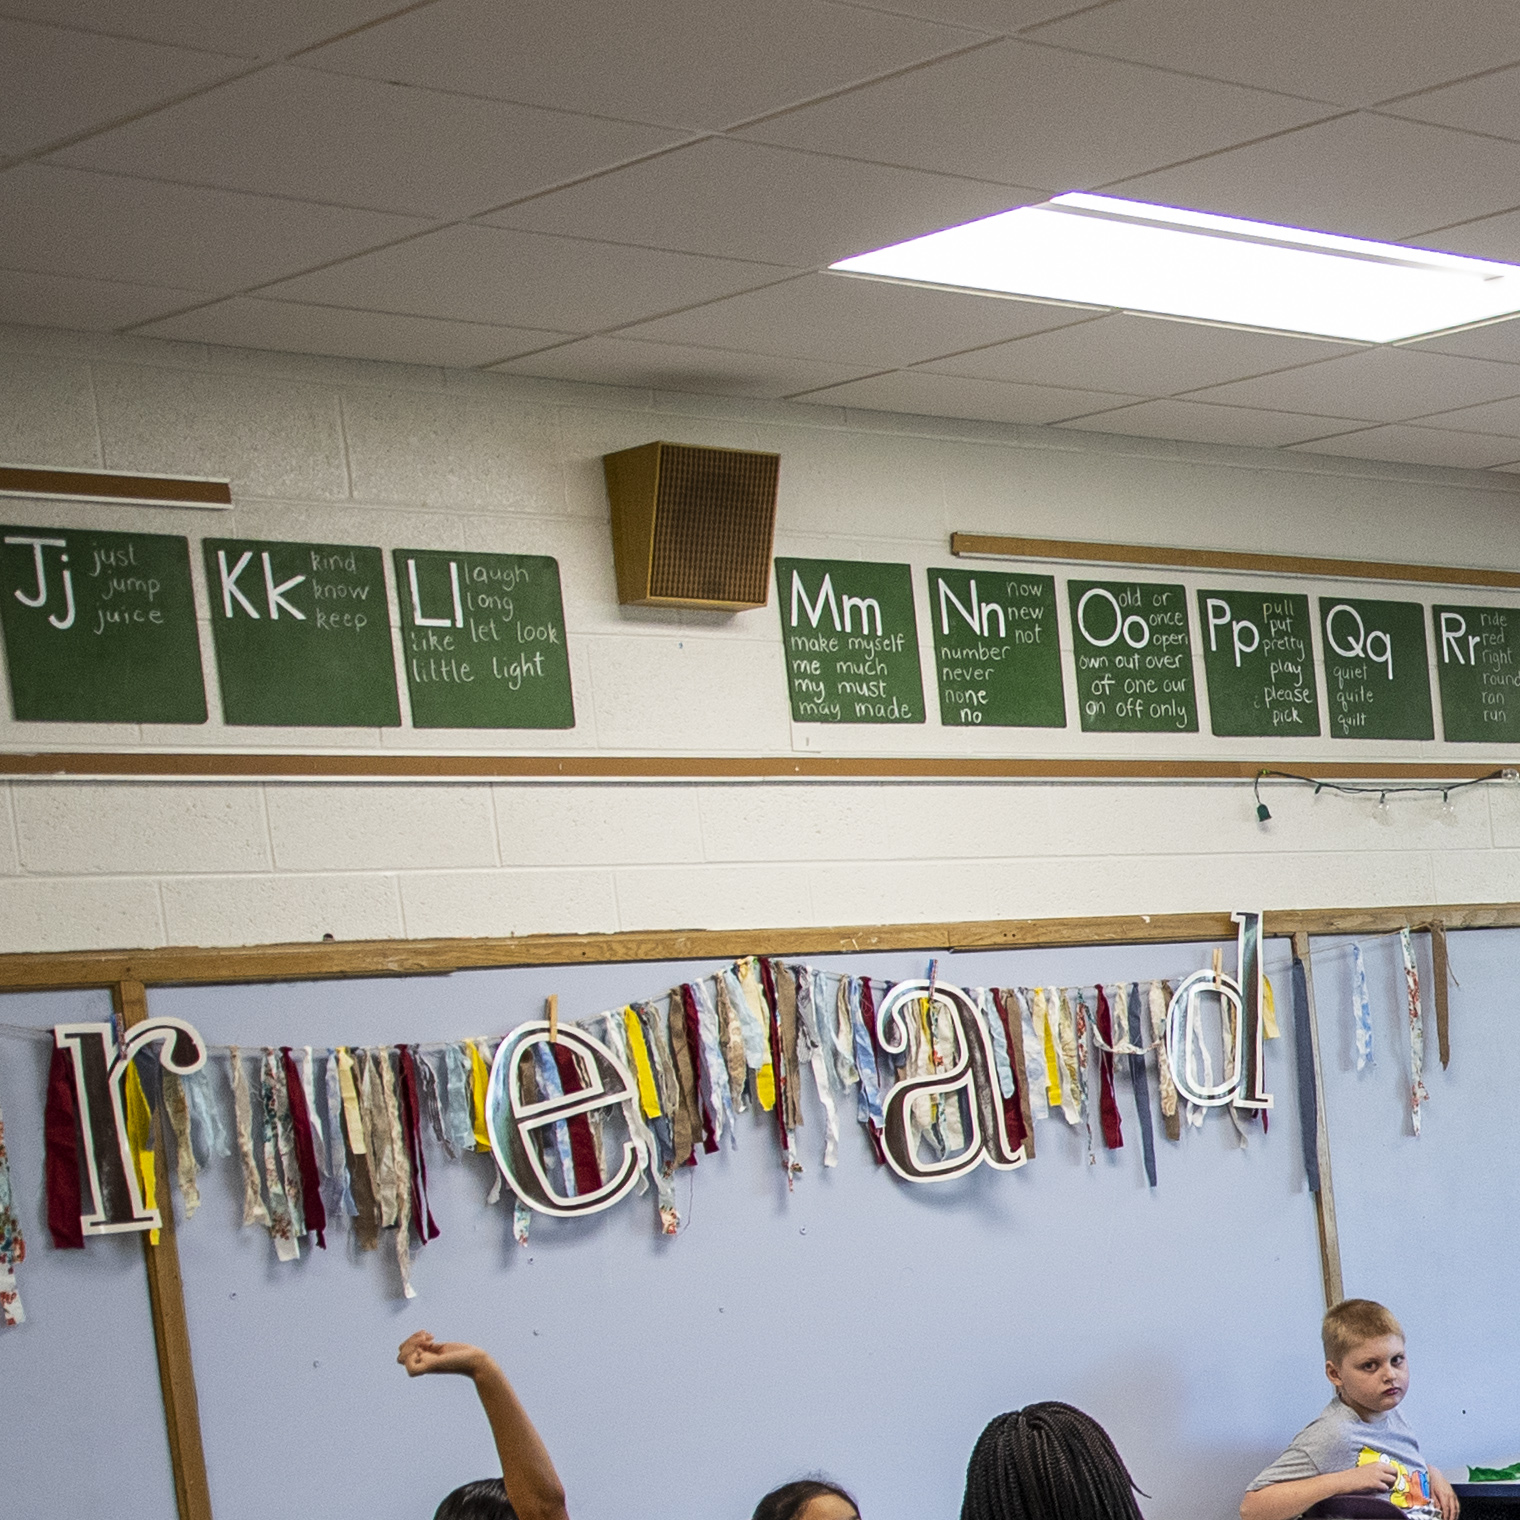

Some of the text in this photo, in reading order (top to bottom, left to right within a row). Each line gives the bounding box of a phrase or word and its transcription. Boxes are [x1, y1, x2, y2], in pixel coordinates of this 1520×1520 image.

[89, 543, 138, 577] just
[311, 551, 356, 574] kind
[4, 536, 76, 629] Jj
[101, 570, 161, 601] jump
[218, 550, 307, 620] Kk
[465, 561, 529, 591] laugh
[313, 579, 369, 600] know
[407, 559, 464, 628] Ll
[1006, 581, 1043, 597] now
[1118, 585, 1173, 607] old or
[467, 592, 514, 622] long
[791, 569, 883, 636] Mm
[938, 577, 1006, 638] Nn
[1007, 606, 1044, 621] new
[1262, 599, 1294, 624] pull
[94, 603, 163, 635] juice
[316, 608, 368, 632] keep
[470, 618, 560, 644] let look
[1077, 588, 1150, 649] Oo
[1149, 612, 1184, 626] once
[1270, 617, 1293, 637] put
[1480, 612, 1508, 627] ride
[411, 629, 455, 652] like
[1014, 623, 1042, 644] not
[1153, 633, 1189, 652] open
[1207, 598, 1260, 668] Pp
[1326, 604, 1393, 680] Qq
[1440, 612, 1480, 665] Rr
[1482, 627, 1505, 646] red
[791, 633, 905, 660] make myself
[940, 642, 1011, 661] number
[1262, 636, 1305, 662] pretty
[413, 651, 545, 690] little light
[792, 657, 888, 676] me much
[1079, 653, 1183, 670] own out over
[1482, 647, 1513, 673] right
[942, 667, 995, 681] never
[1091, 673, 1187, 695] of one our
[1270, 659, 1303, 687] play
[1333, 662, 1368, 690] quiet
[794, 678, 887, 703] my must
[944, 689, 989, 706] none
[1264, 685, 1313, 709] please
[1481, 691, 1505, 705] ran
[799, 696, 912, 722] may made
[960, 708, 982, 723] no
[1085, 697, 1188, 729] on off only
[1273, 706, 1303, 726] pick
[1483, 709, 1507, 722] run
